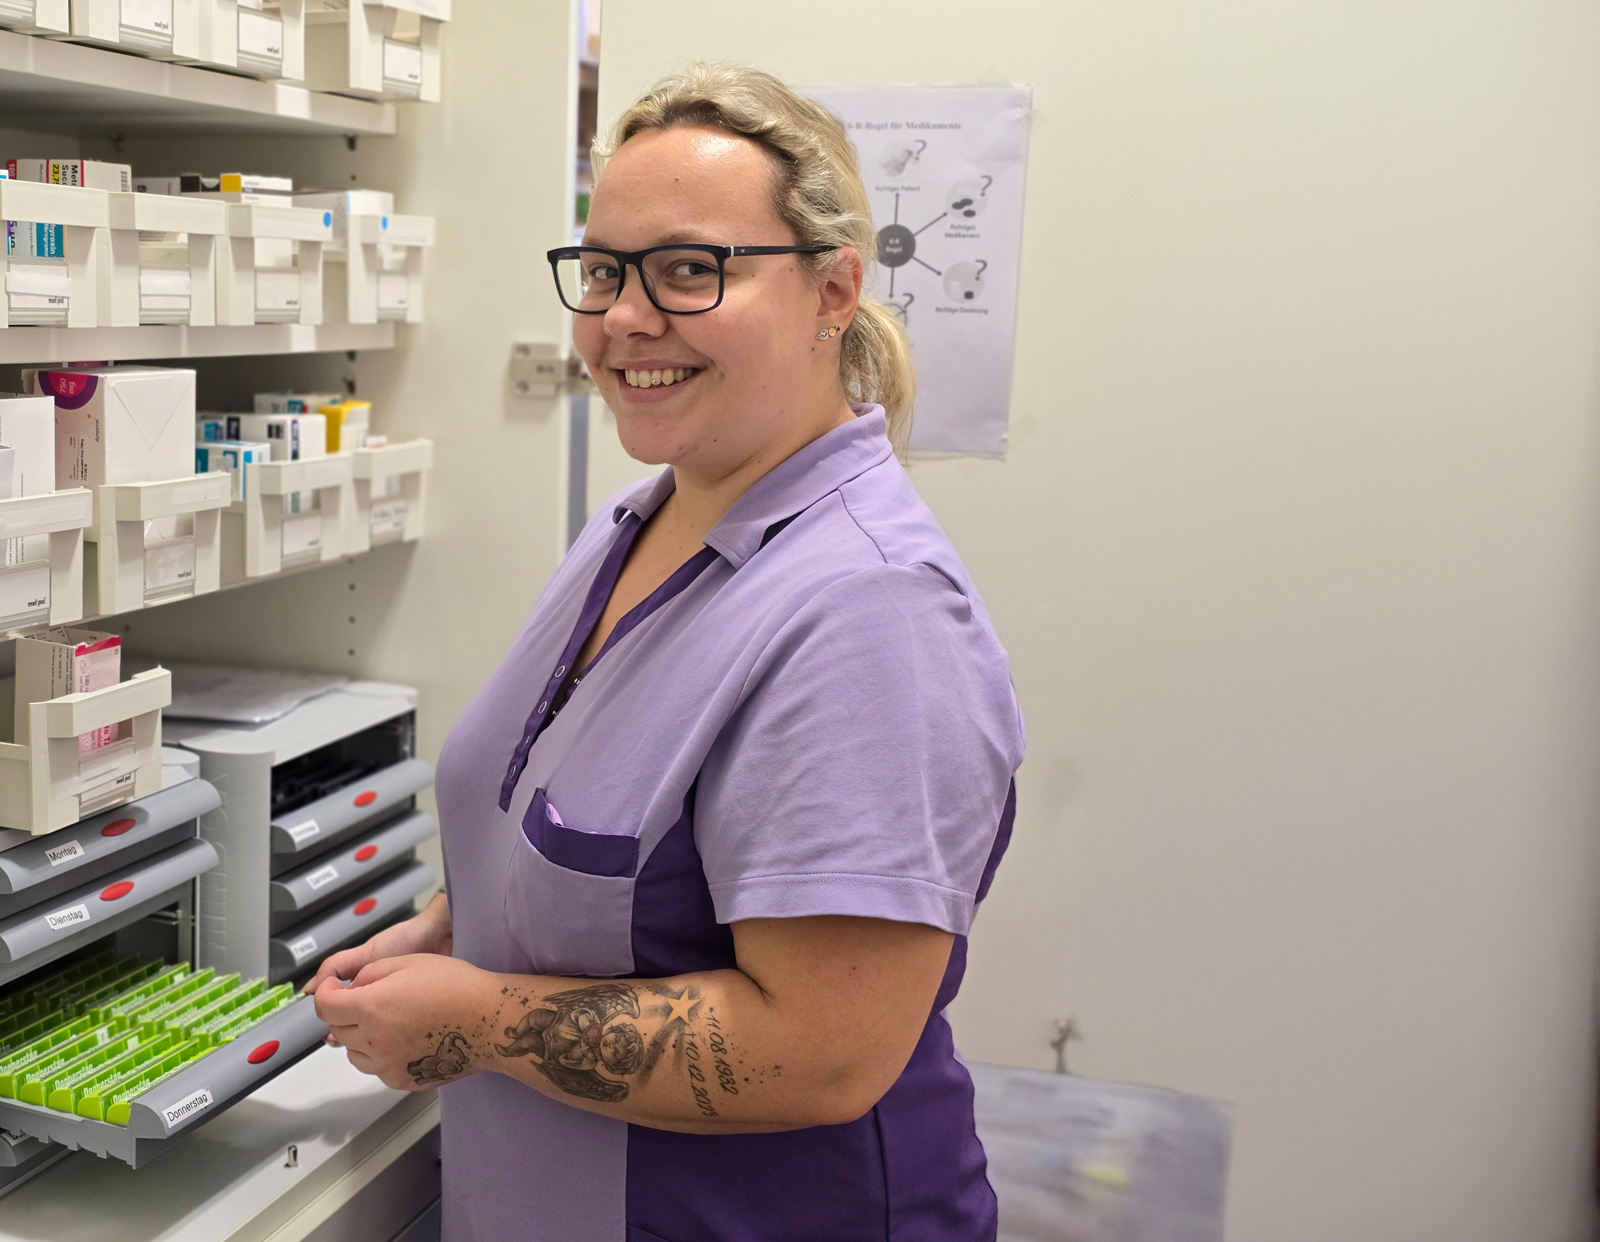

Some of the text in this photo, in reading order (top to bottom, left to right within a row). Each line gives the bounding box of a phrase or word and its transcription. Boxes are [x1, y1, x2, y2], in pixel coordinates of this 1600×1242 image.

[890, 121, 902, 130] für
[905, 121, 962, 130] Medikamente
[950, 224, 976, 232] Richtiges
[959, 307, 988, 315] Dosierung
[69, 381, 76, 394] mg
[48, 846, 77, 863] Montag
[49, 910, 83, 927] Dienstag
[166, 1093, 208, 1122] Donnerstag
